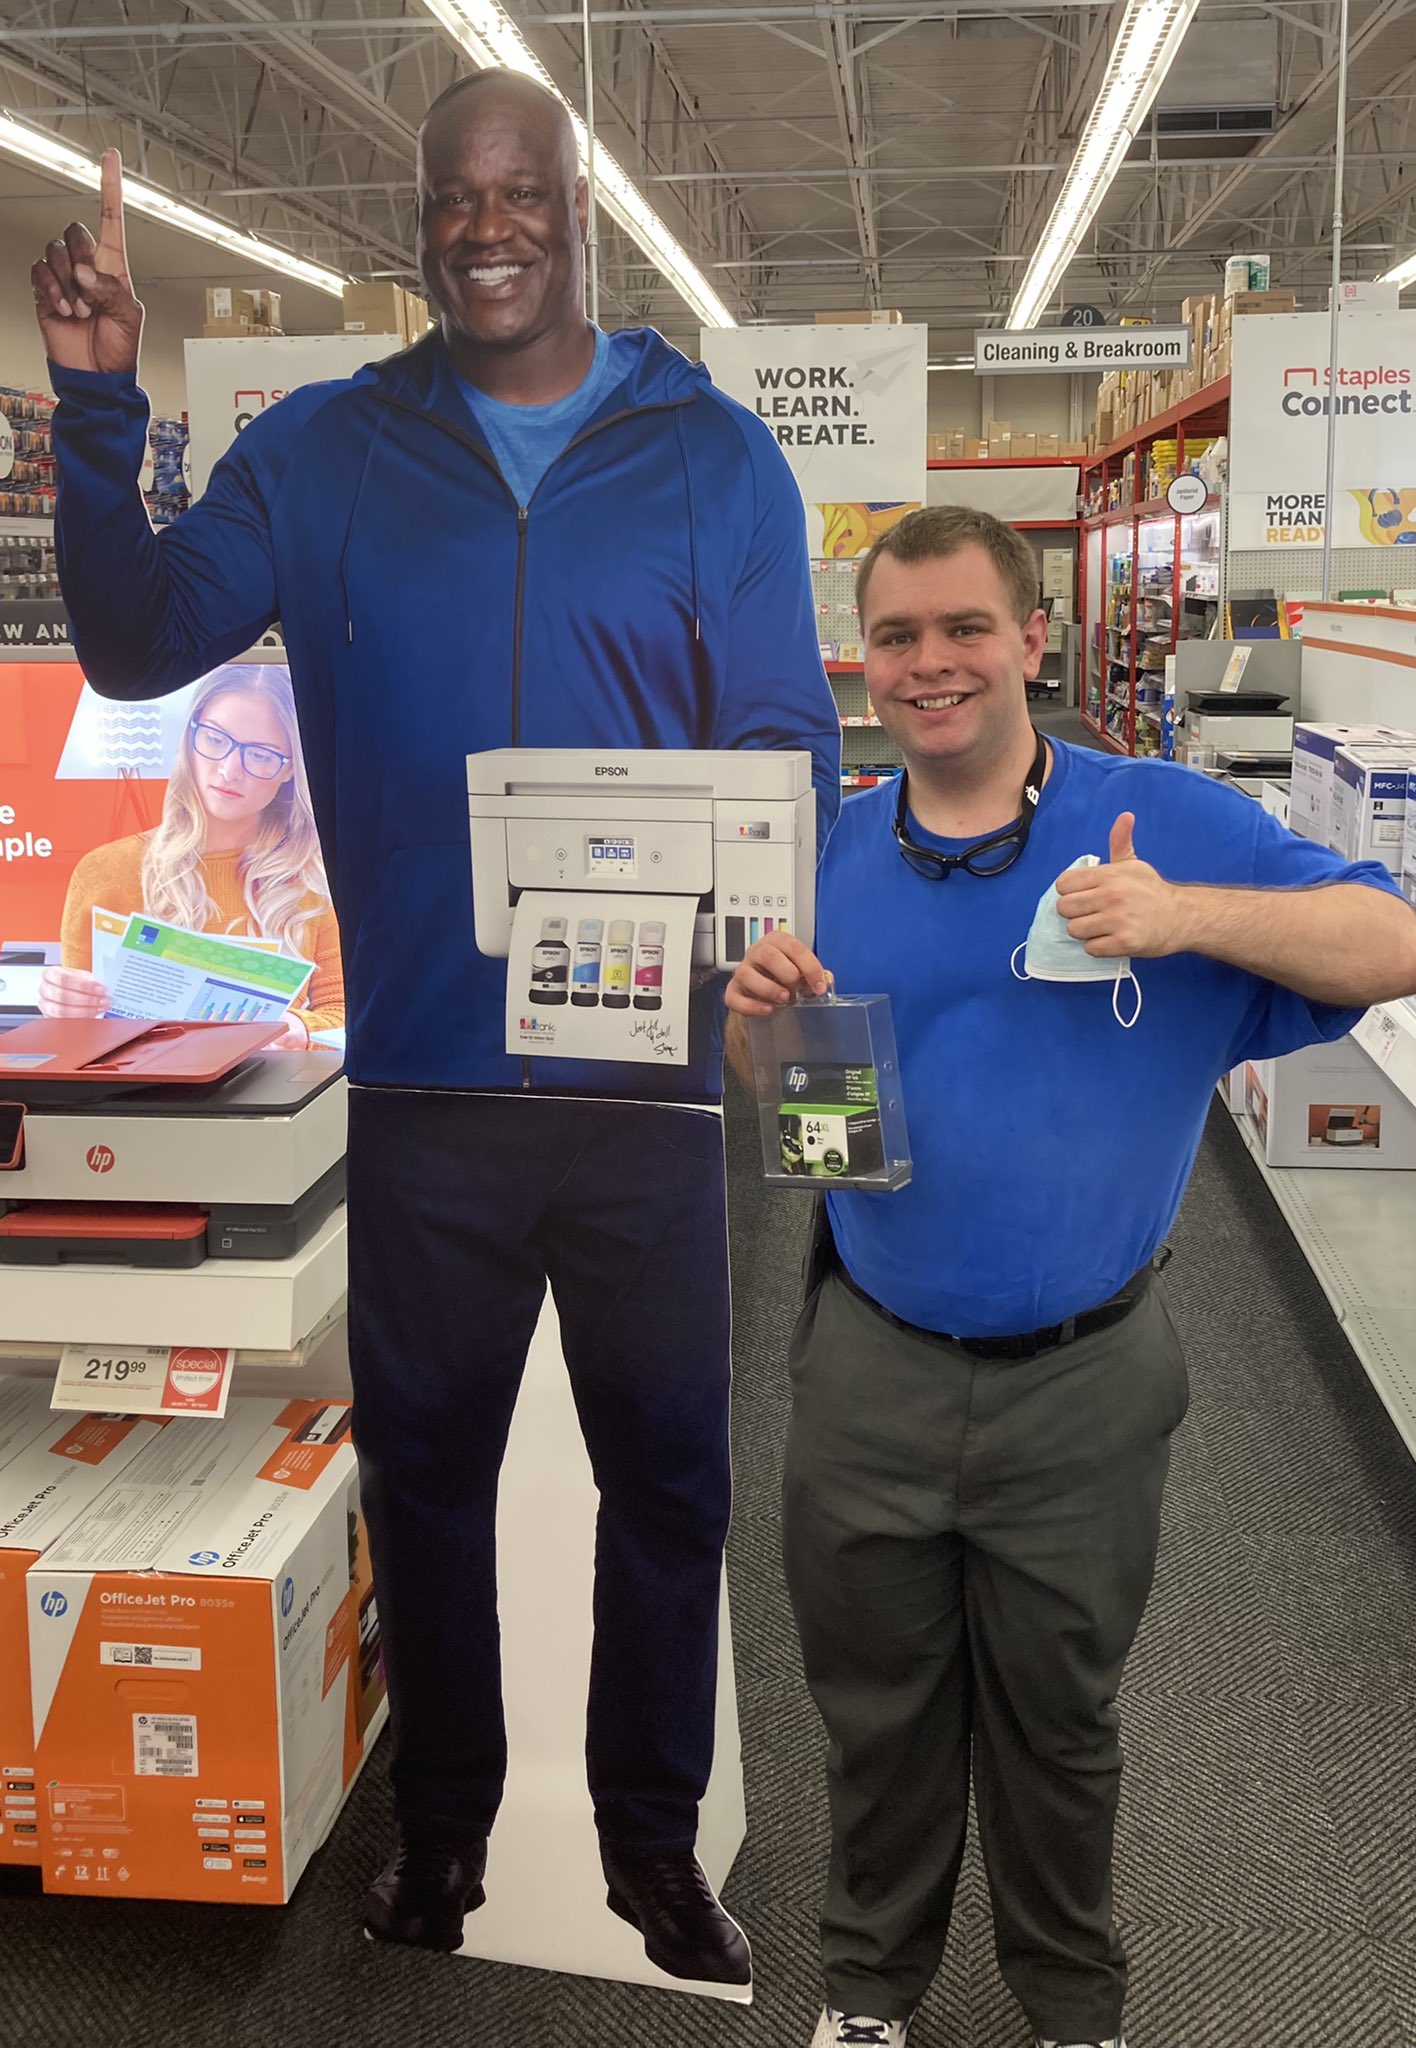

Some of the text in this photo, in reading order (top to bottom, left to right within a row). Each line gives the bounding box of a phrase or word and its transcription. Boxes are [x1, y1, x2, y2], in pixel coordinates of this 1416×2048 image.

[1072, 308, 1094, 326] 20
[983, 339, 1181, 363] Cleaning & Breakroom
[754, 366, 855, 389] WORK.
[1323, 365, 1411, 390] Staples
[755, 395, 859, 418] LEARN.
[1281, 389, 1412, 417] Connect
[770, 424, 875, 446] REATE.
[1267, 494, 1326, 510] MORE
[1265, 511, 1322, 526] THAN
[594, 766, 629, 777] EPSON
[0, 832, 53, 862] ple
[787, 1066, 808, 1092] hp
[89, 1145, 112, 1173] hp
[175, 1358, 217, 1371] special
[175, 1373, 214, 1383] limited time
[34, 1485, 57, 1500] Pro
[222, 1529, 262, 1568] OfficeJet
[252, 1512, 273, 1528] Pro
[42, 1591, 66, 1617] hp
[99, 1591, 167, 1606] OfficeJet
[170, 1594, 196, 1607] Pro
